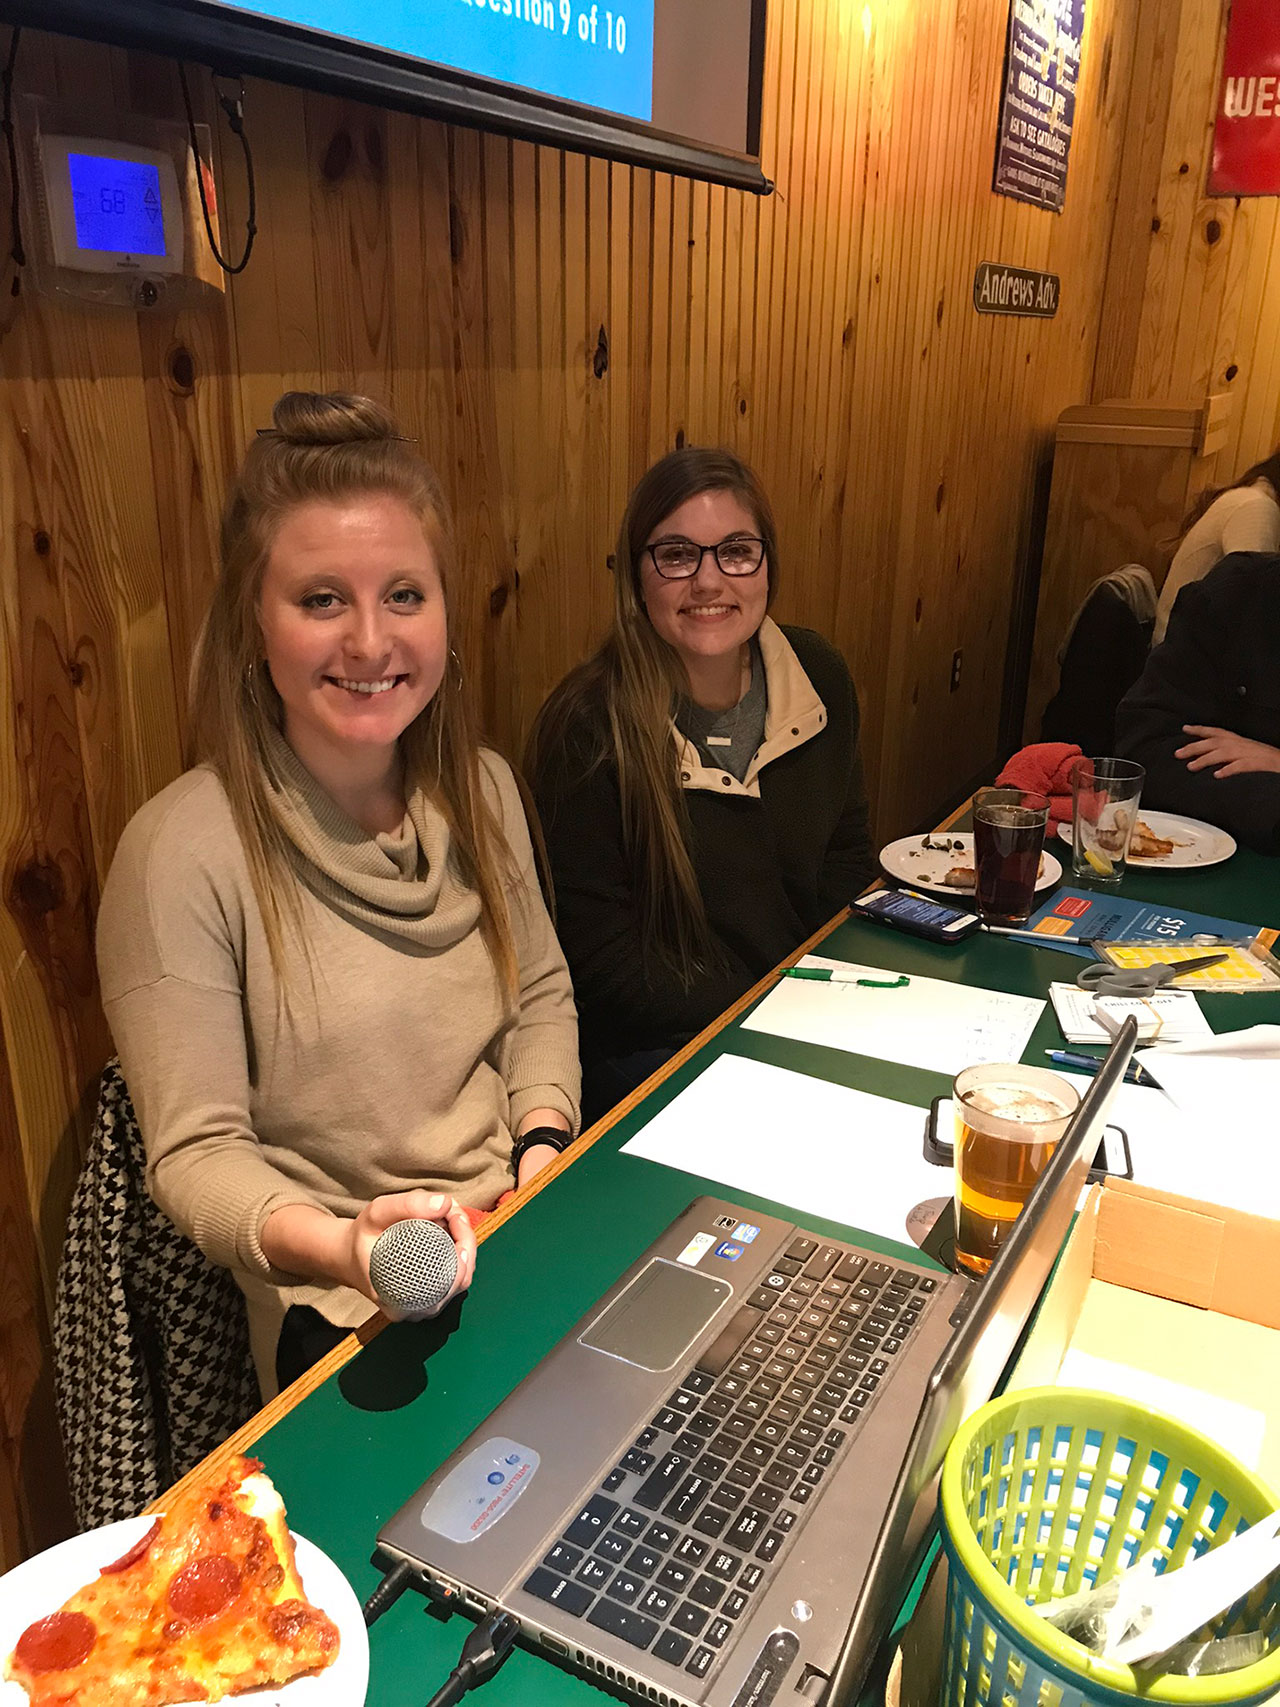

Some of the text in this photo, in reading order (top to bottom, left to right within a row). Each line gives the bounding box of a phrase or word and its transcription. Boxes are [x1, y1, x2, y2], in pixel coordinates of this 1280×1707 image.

[461, 0, 627, 54] stion 9 of 10
[980, 265, 1035, 307] Andrews
[1156, 916, 1188, 936] $15
[789, 1297, 800, 1305] X
[849, 1303, 861, 1311] W
[739, 1363, 751, 1371] N
[773, 1364, 784, 1372] H
[725, 1380, 738, 1390] M
[791, 1389, 803, 1397] U
[747, 1400, 758, 1409] K
[765, 1426, 777, 1435] O
[688, 1478, 702, 1494] ENTER
[692, 1546, 703, 1556] 7
[643, 1556, 653, 1566] 5
[593, 1567, 604, 1577] 3
[551, 1580, 568, 1599] ENTER
